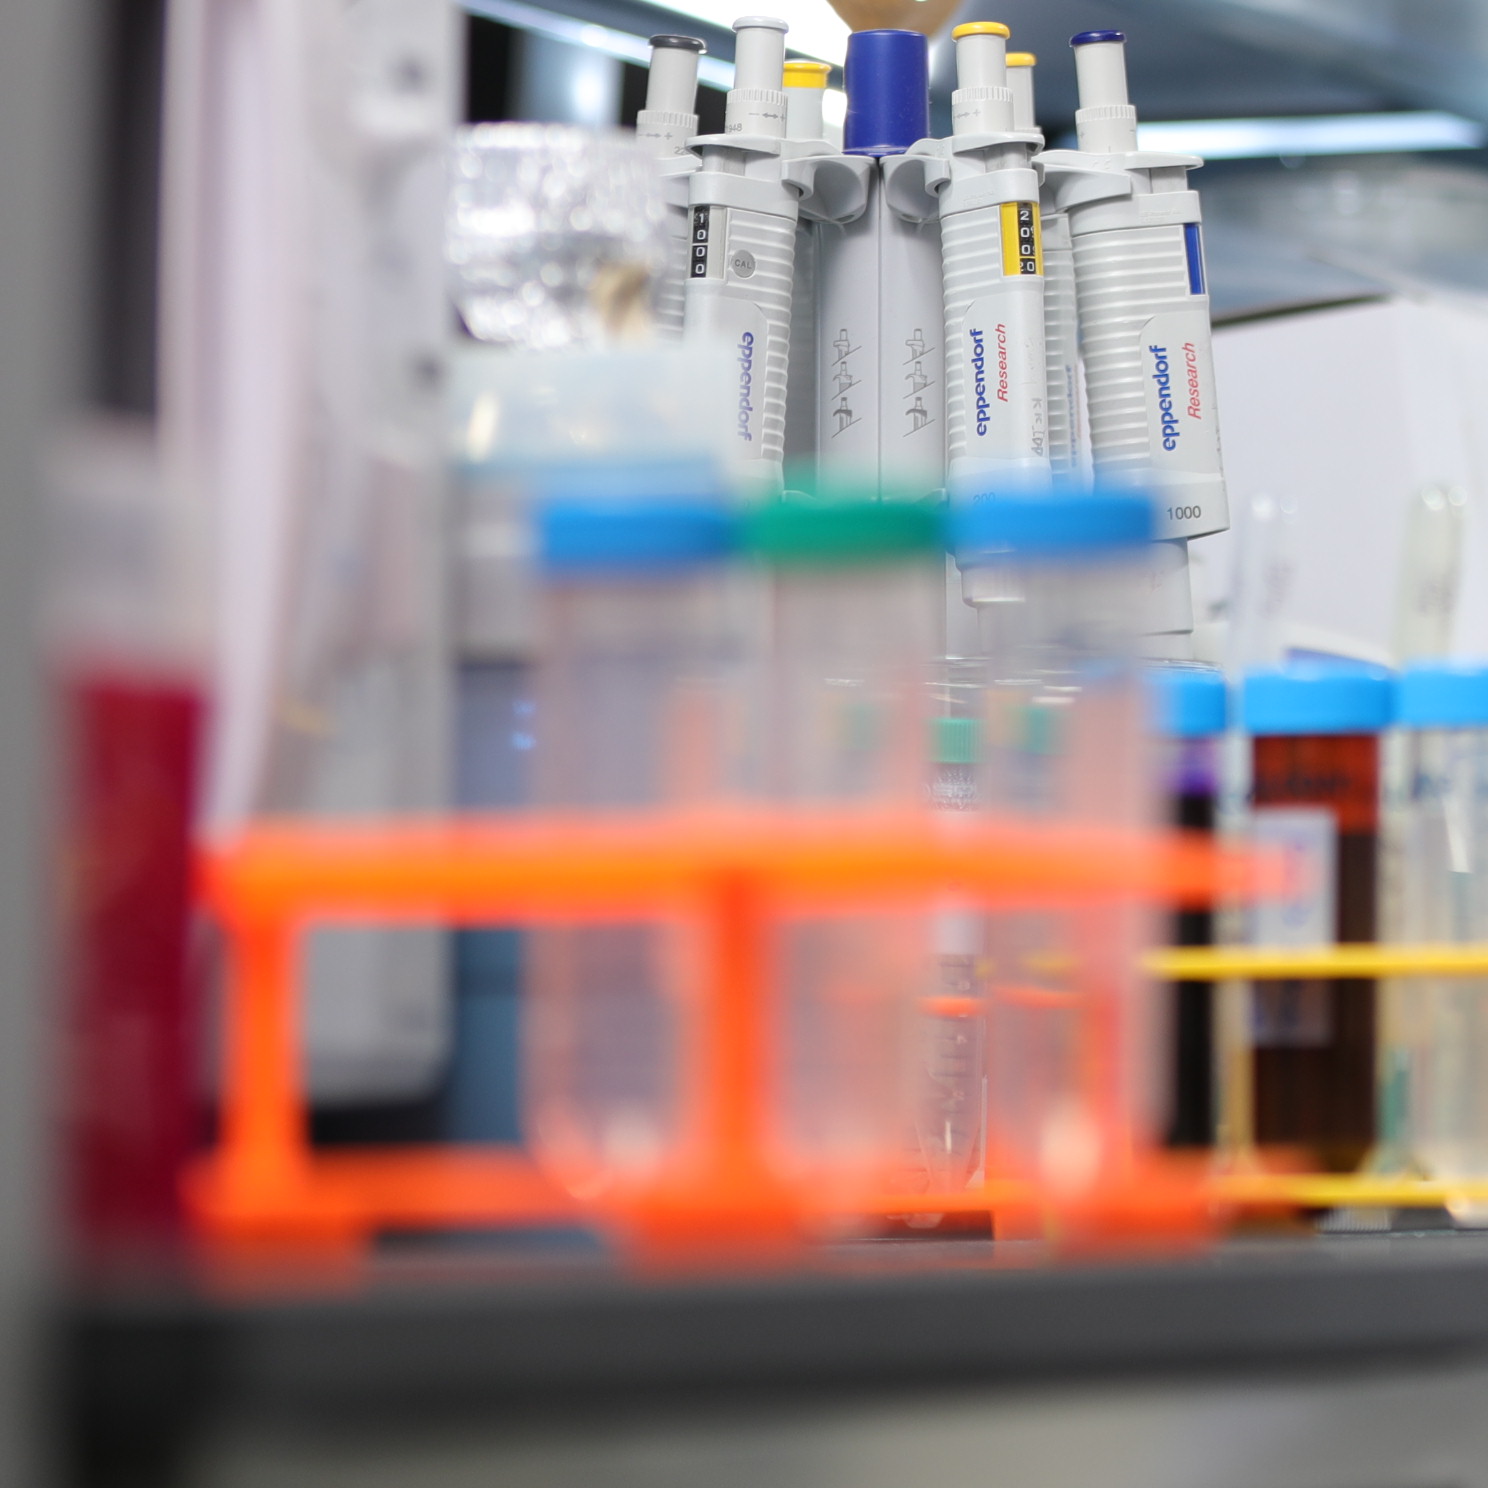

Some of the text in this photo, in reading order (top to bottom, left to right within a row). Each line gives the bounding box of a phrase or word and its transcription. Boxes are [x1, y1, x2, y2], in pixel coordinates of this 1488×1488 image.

[737, 331, 754, 442] eppendorf
[969, 328, 991, 437] eppendorf
[994, 323, 1009, 403] Research
[1149, 345, 1180, 452] eppendorf
[1181, 342, 1202, 420] Research
[1166, 505, 1202, 521] 1000
